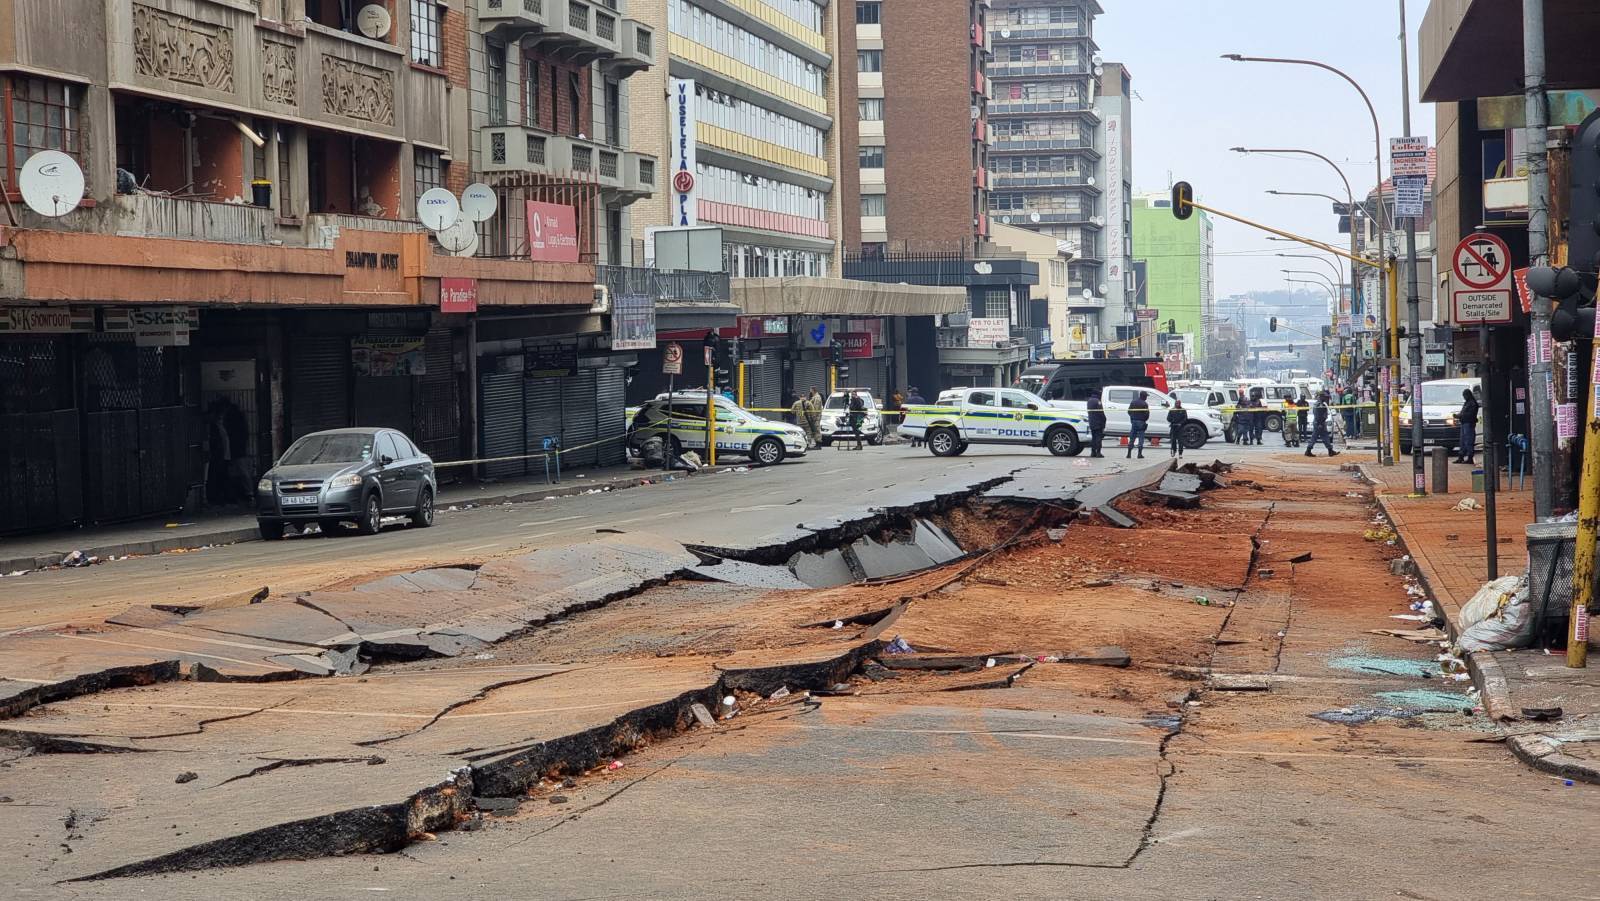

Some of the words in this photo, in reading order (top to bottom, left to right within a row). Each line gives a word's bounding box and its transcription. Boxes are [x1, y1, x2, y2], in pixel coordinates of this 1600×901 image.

[678, 83, 687, 170] VUSELELA
[381, 253, 399, 271] COURT
[1468, 294, 1497, 302] OUTSIDE
[1462, 302, 1503, 310] Demarcated
[31, 312, 71, 328] showroom
[998, 429, 1037, 437] POLICE
[714, 441, 748, 450] OLICE
